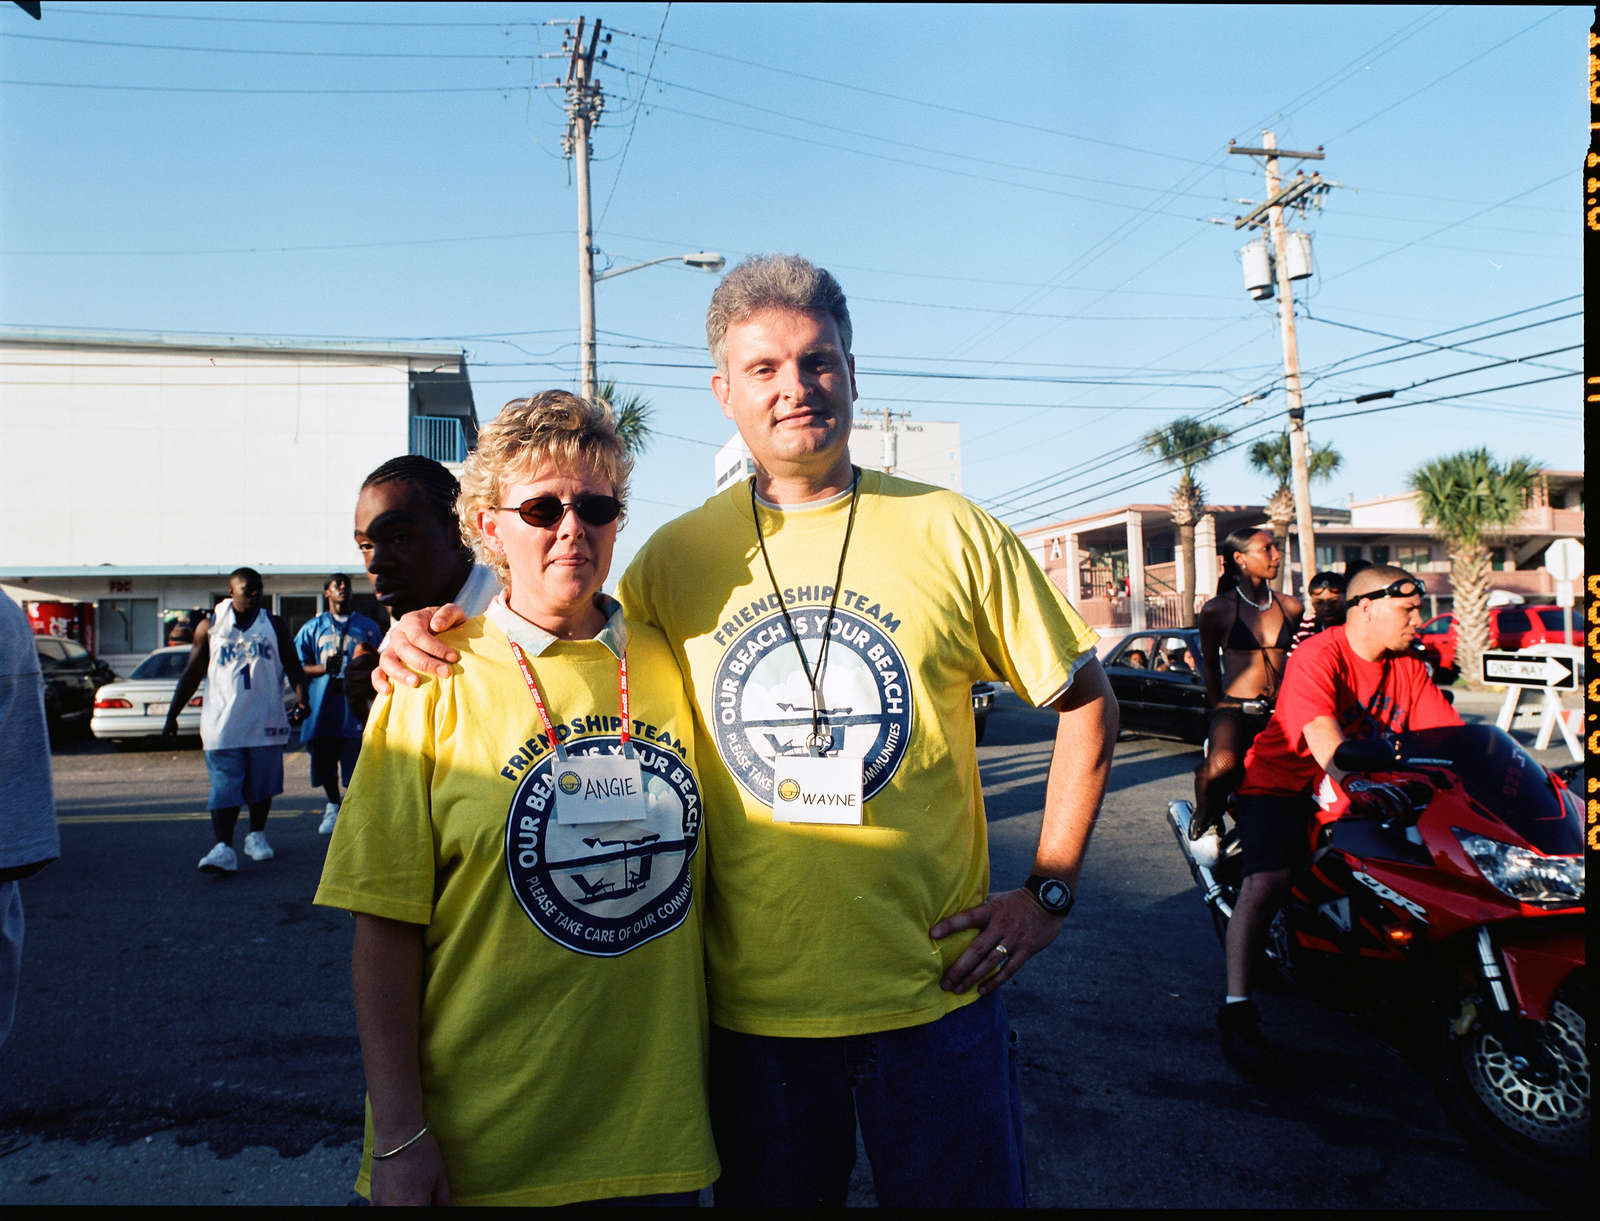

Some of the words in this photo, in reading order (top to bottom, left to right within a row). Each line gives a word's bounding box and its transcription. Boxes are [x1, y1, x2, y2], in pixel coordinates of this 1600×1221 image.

[714, 586, 835, 646] FRIENDSHIP
[844, 590, 901, 633] TEAM
[814, 616, 871, 648] YOUR
[729, 623, 787, 676] BEACH
[1490, 662, 1513, 674] ONE
[1520, 663, 1545, 674] WAY
[239, 663, 252, 690] 1
[720, 677, 740, 725] OUR
[867, 643, 903, 714] BEACH
[501, 715, 622, 781] FRIENDSHIP
[632, 720, 687, 759] TEAM
[608, 744, 668, 773] YUR
[726, 732, 752, 771] PLEASE
[749, 766, 773, 792] TAKE
[863, 722, 901, 785] OMMUNITIES
[526, 772, 554, 812] BEA
[584, 777, 637, 801] ANGIE
[671, 767, 698, 837] BEACH
[802, 793, 857, 807] WAYNE
[518, 815, 541, 869] OUR
[526, 875, 557, 917] PLEASE
[554, 911, 583, 936] TAKE
[584, 927, 615, 942] CARE
[618, 926, 632, 941] OF
[633, 914, 657, 934] OUR
[657, 872, 692, 919] COMMU
[1352, 871, 1431, 924] CBR
